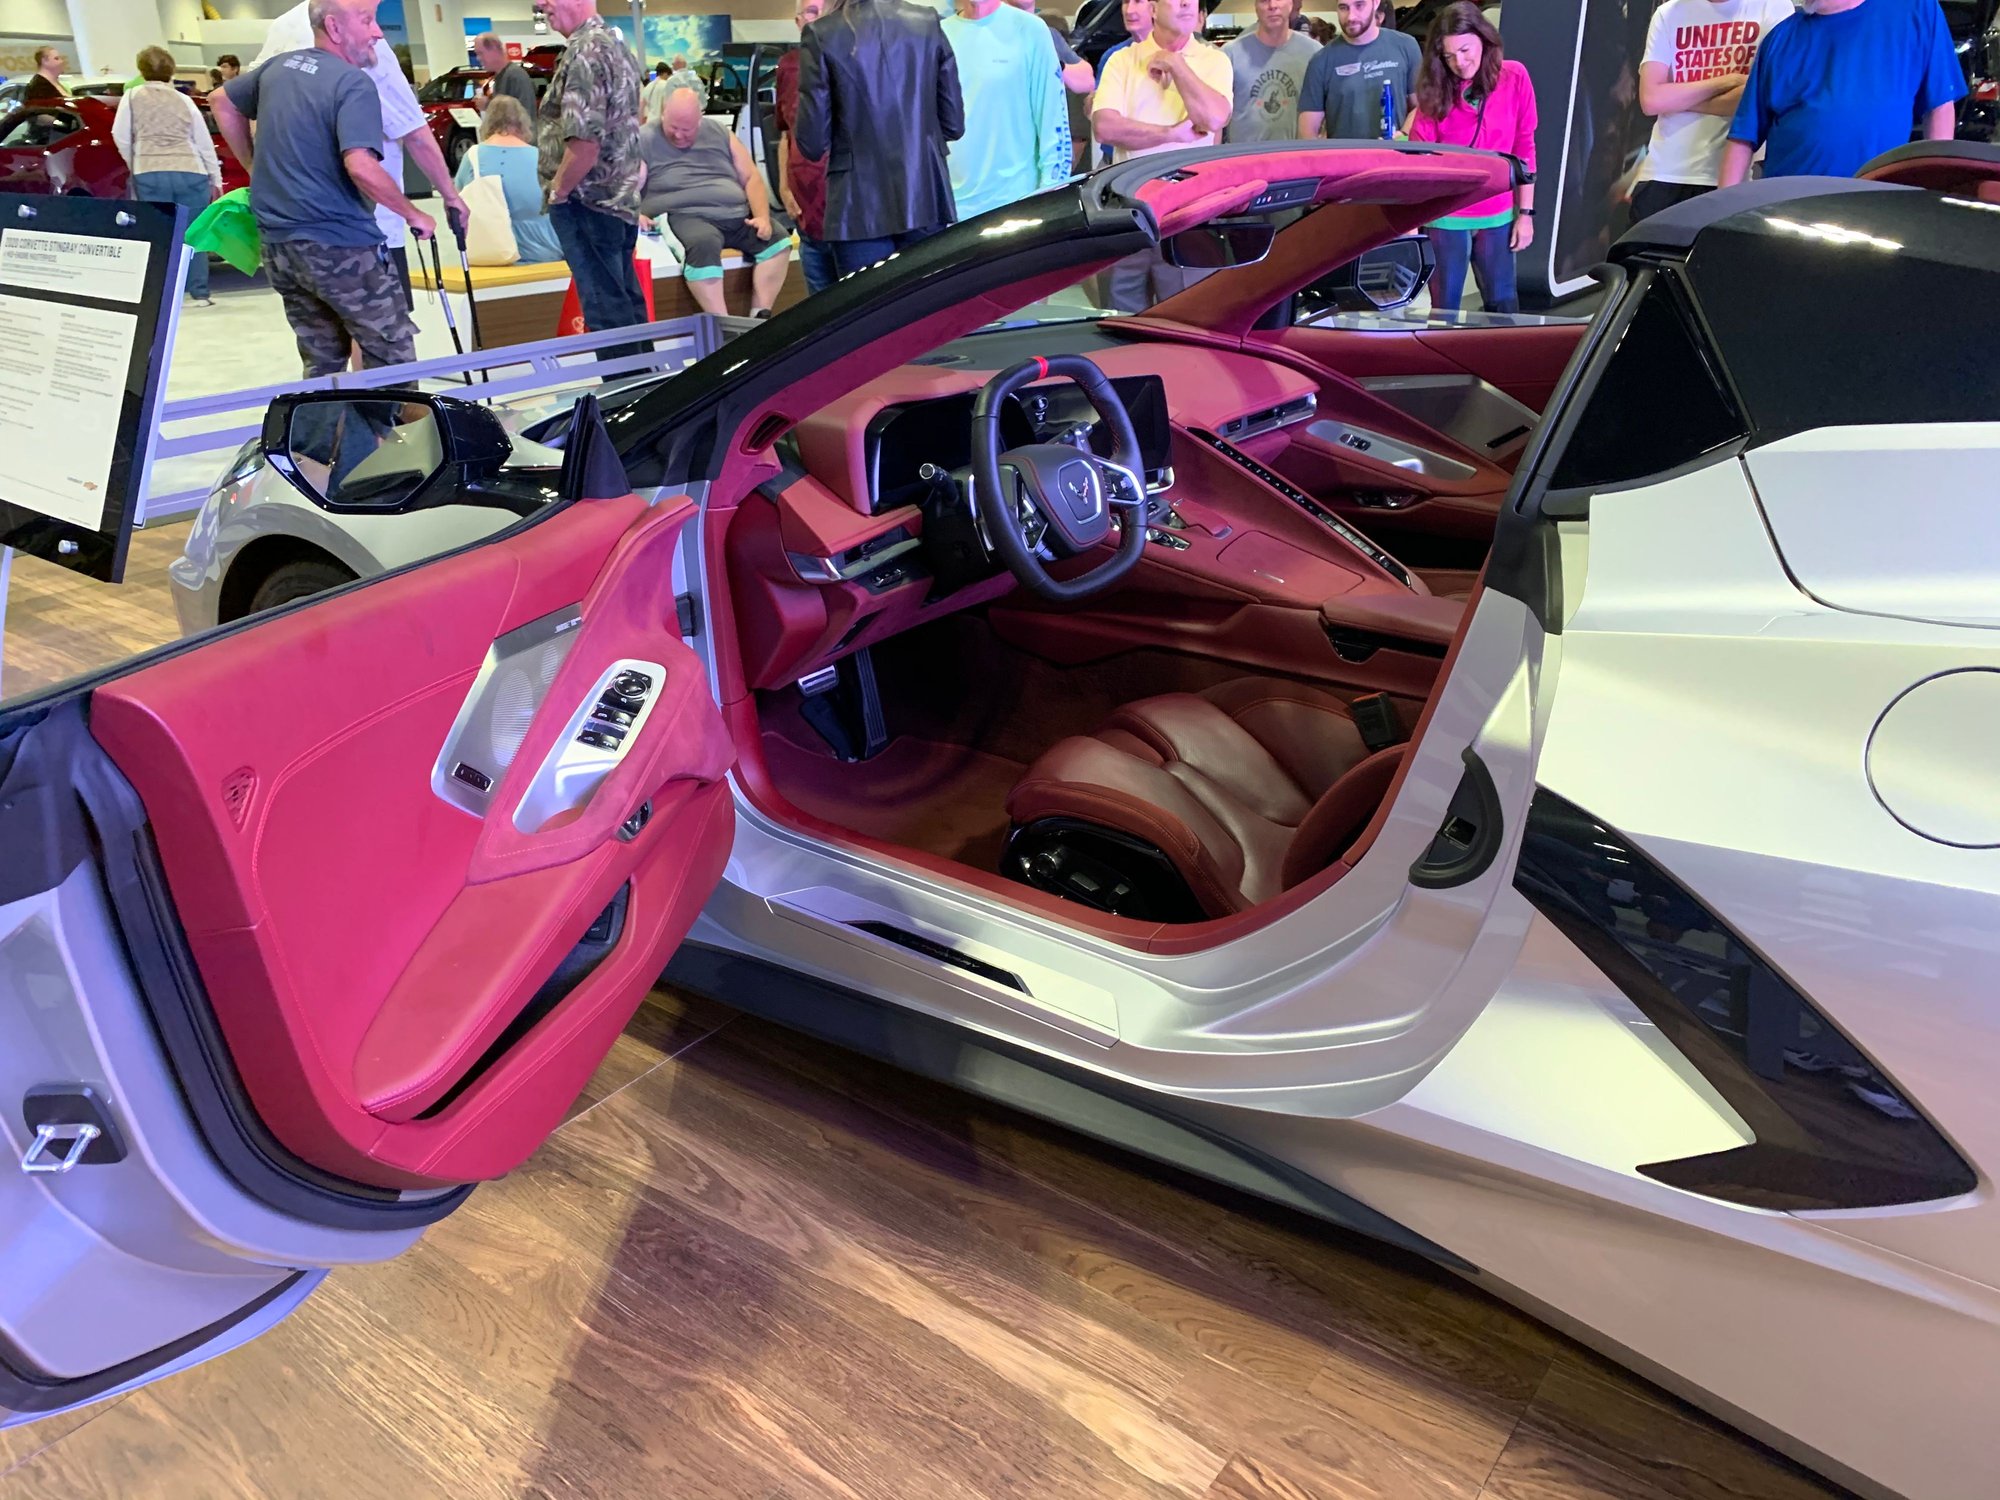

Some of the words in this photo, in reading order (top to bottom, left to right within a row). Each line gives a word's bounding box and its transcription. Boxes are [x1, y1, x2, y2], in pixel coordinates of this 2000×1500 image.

[1675, 21, 1761, 50] UNITED
[1675, 47, 1732, 70] STATES
[1733, 45, 1757, 65] OF
[79, 242, 122, 258] CONVERTIBLE
